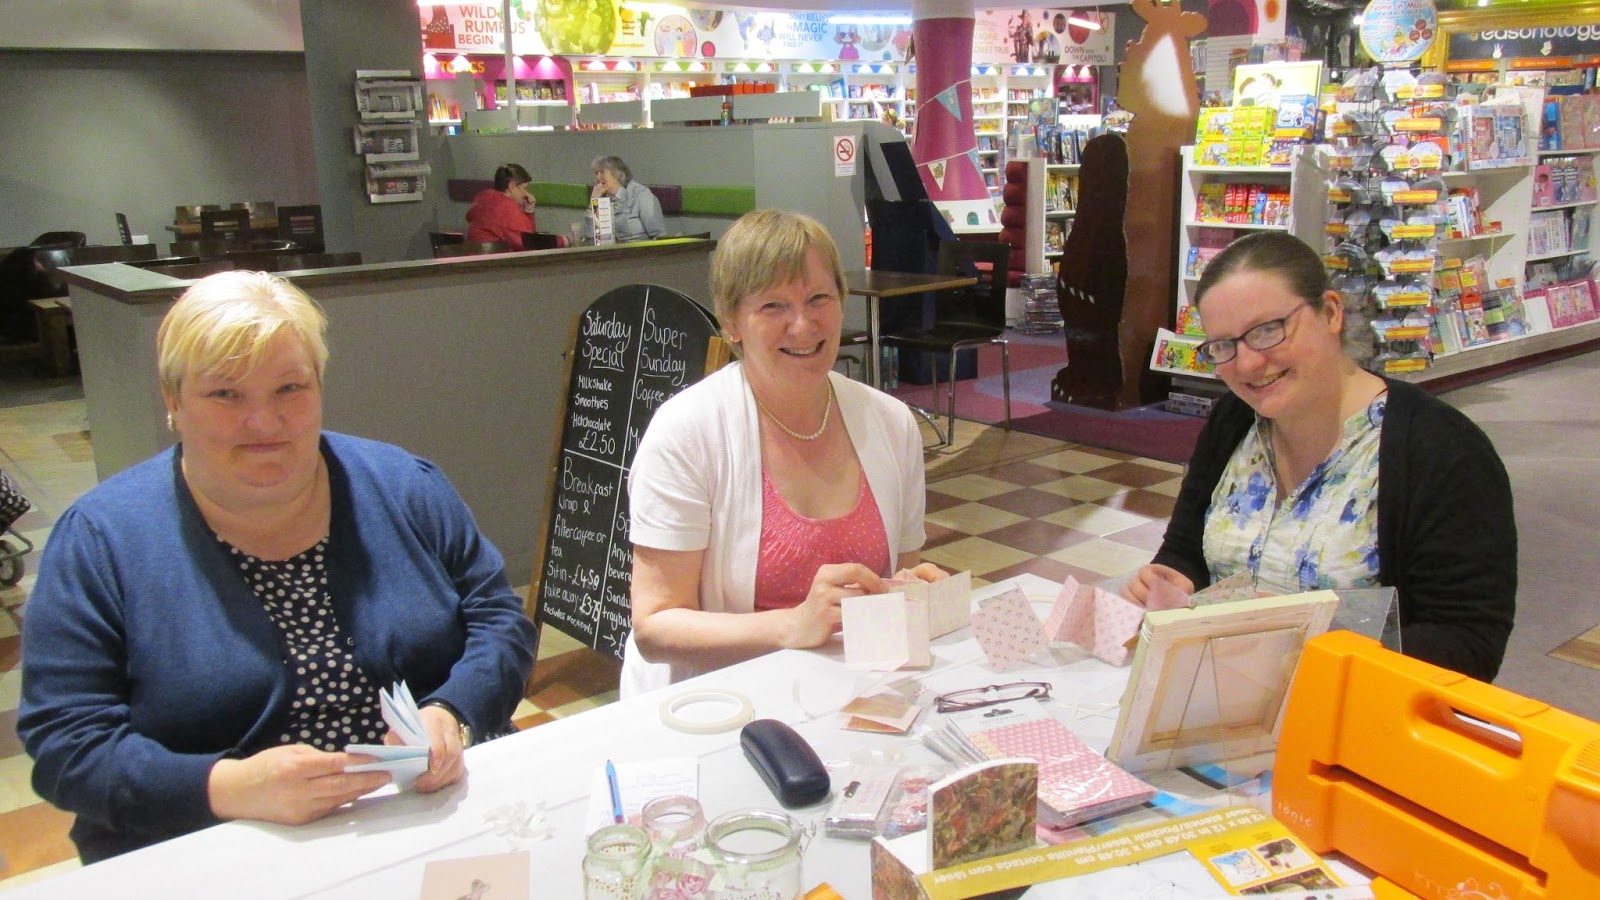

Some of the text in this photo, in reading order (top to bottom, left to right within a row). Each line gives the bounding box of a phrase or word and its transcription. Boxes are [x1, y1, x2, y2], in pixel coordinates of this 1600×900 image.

[460, 6, 497, 19] WILD
[793, 22, 828, 34] MAGIC
[798, 33, 824, 42] NEVER
[458, 34, 494, 45] BEGIN
[1064, 46, 1086, 54] DOWN
[583, 310, 631, 353] Saturday
[644, 307, 688, 357] Super
[583, 339, 625, 370] Special
[641, 346, 686, 387] Sunday
[635, 378, 665, 410] Coffee
[563, 456, 614, 505] Breakfast
[551, 538, 563, 558] tea
[611, 542, 627, 569] Any
[608, 563, 632, 582] bevera
[543, 579, 561, 599] take
[967, 863, 994, 876] con
